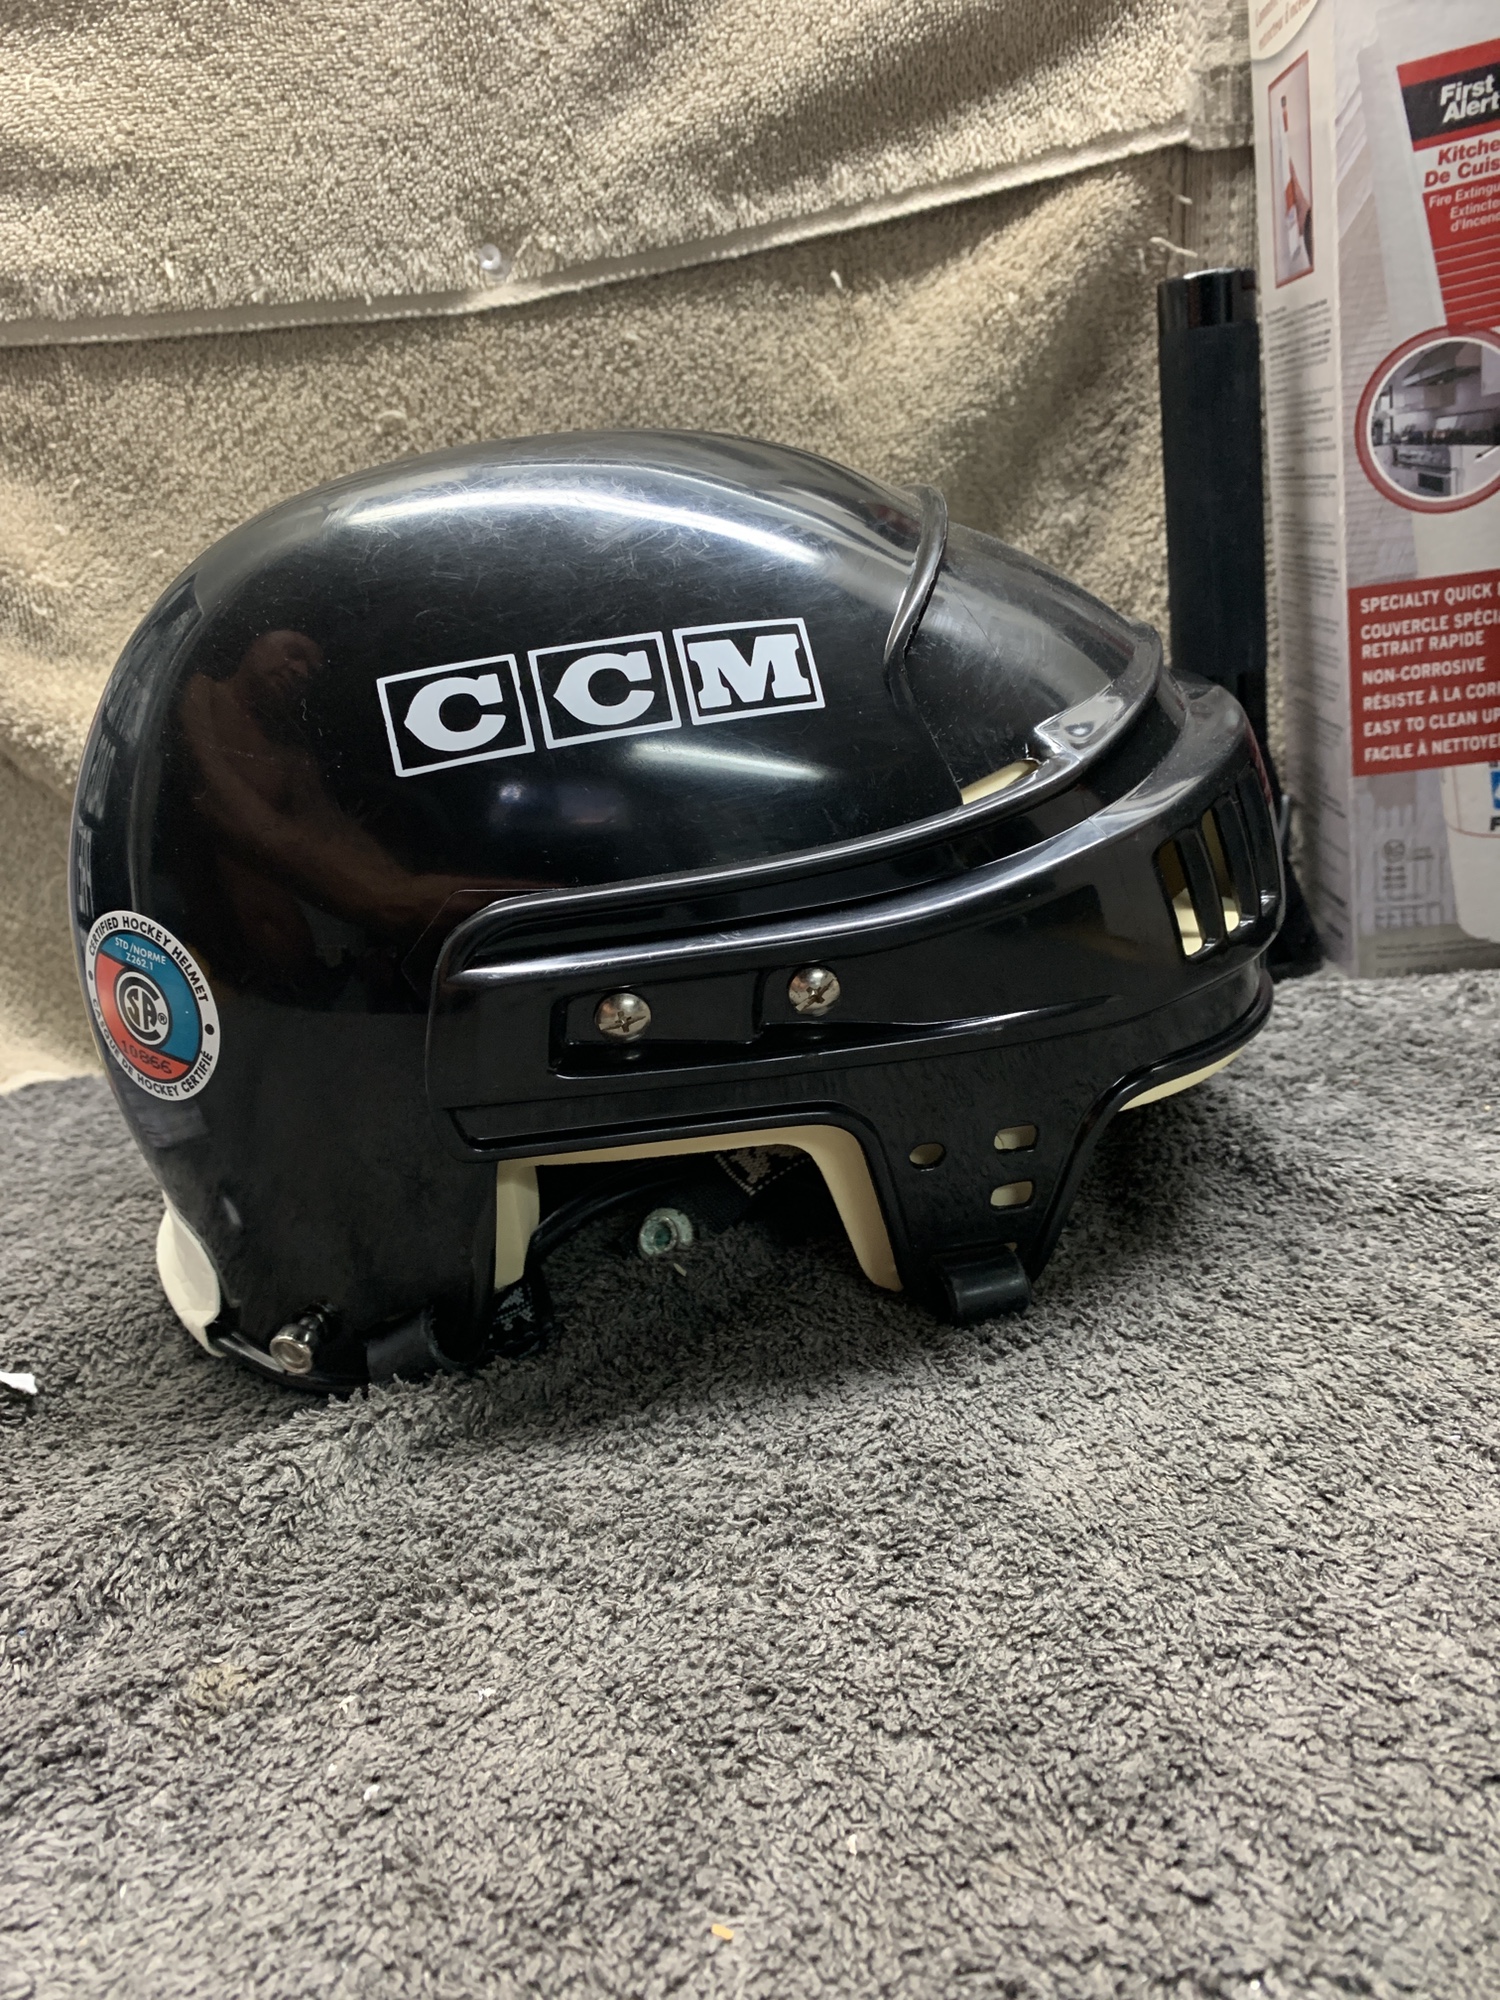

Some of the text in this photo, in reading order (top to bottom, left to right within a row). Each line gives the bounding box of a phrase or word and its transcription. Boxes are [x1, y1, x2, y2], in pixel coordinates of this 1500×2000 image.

[1440, 74, 1495, 107] First
[1442, 91, 1500, 124] Alert
[1424, 170, 1451, 188] De
[1428, 195, 1453, 209] Fire
[1360, 588, 1441, 614] SPECIALTY
[1444, 582, 1493, 606] QUICK
[1361, 607, 1500, 640] COUVERCLE SPÉCI
[1362, 630, 1485, 660] RETRAIT RAPIDE
[1362, 656, 1486, 685] NON-CORROSIVE
[404, 634, 811, 751] CCM
[1363, 680, 1500, 712] RÉSISTE À LA COR
[1363, 719, 1401, 737] EASY
[1405, 716, 1425, 732] TO
[1429, 710, 1477, 730] CLEAN
[1364, 732, 1500, 763] FACILE À NETTOYE
[115, 937, 129, 950] STD
[89, 916, 209, 1003] CERTIFIED HOCKEY HELMET
[126, 952, 154, 971] Z262.1
[92, 998, 120, 1058] CASQUE
[121, 1058, 134, 1076] DE
[137, 1073, 180, 1097] HOCKEY
